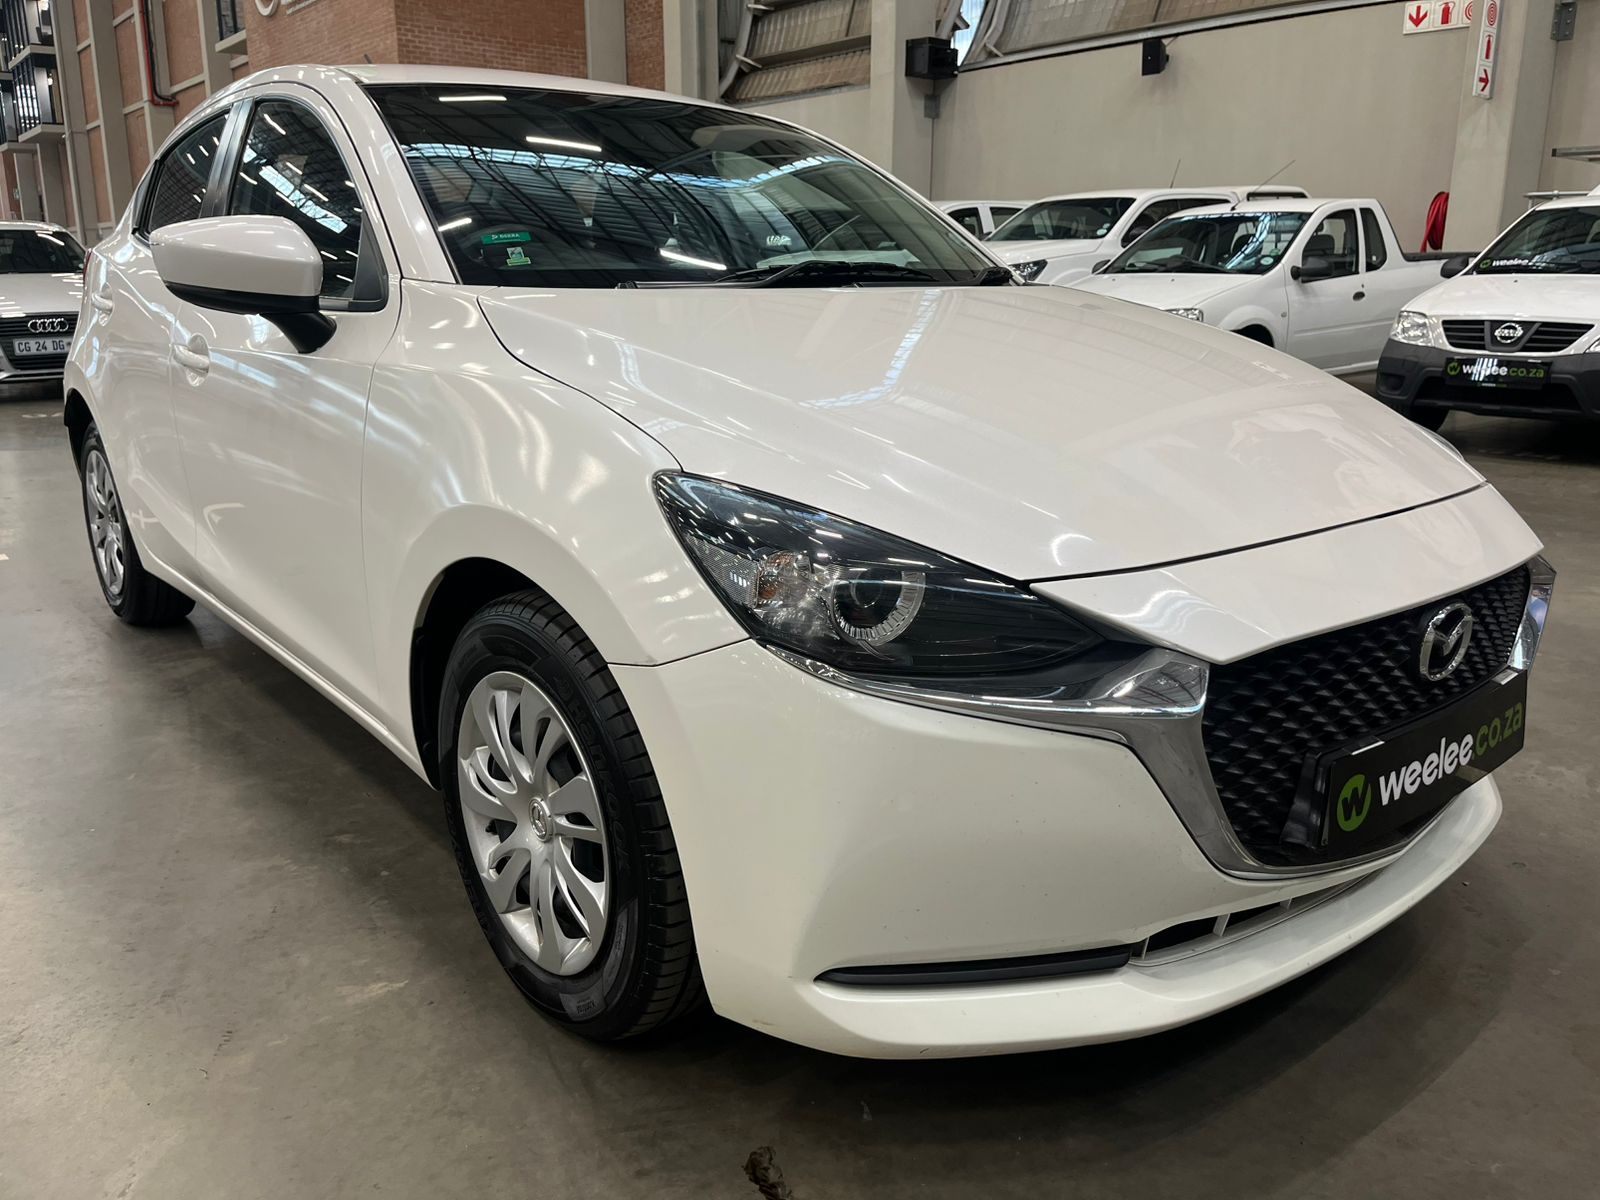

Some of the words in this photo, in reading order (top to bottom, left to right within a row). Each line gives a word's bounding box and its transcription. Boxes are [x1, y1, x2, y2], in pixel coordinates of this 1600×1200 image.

[17, 341, 31, 353] CG
[35, 341, 47, 352] 24
[52, 340, 65, 351] DG
[1379, 702, 1523, 806] weelee.co.za
